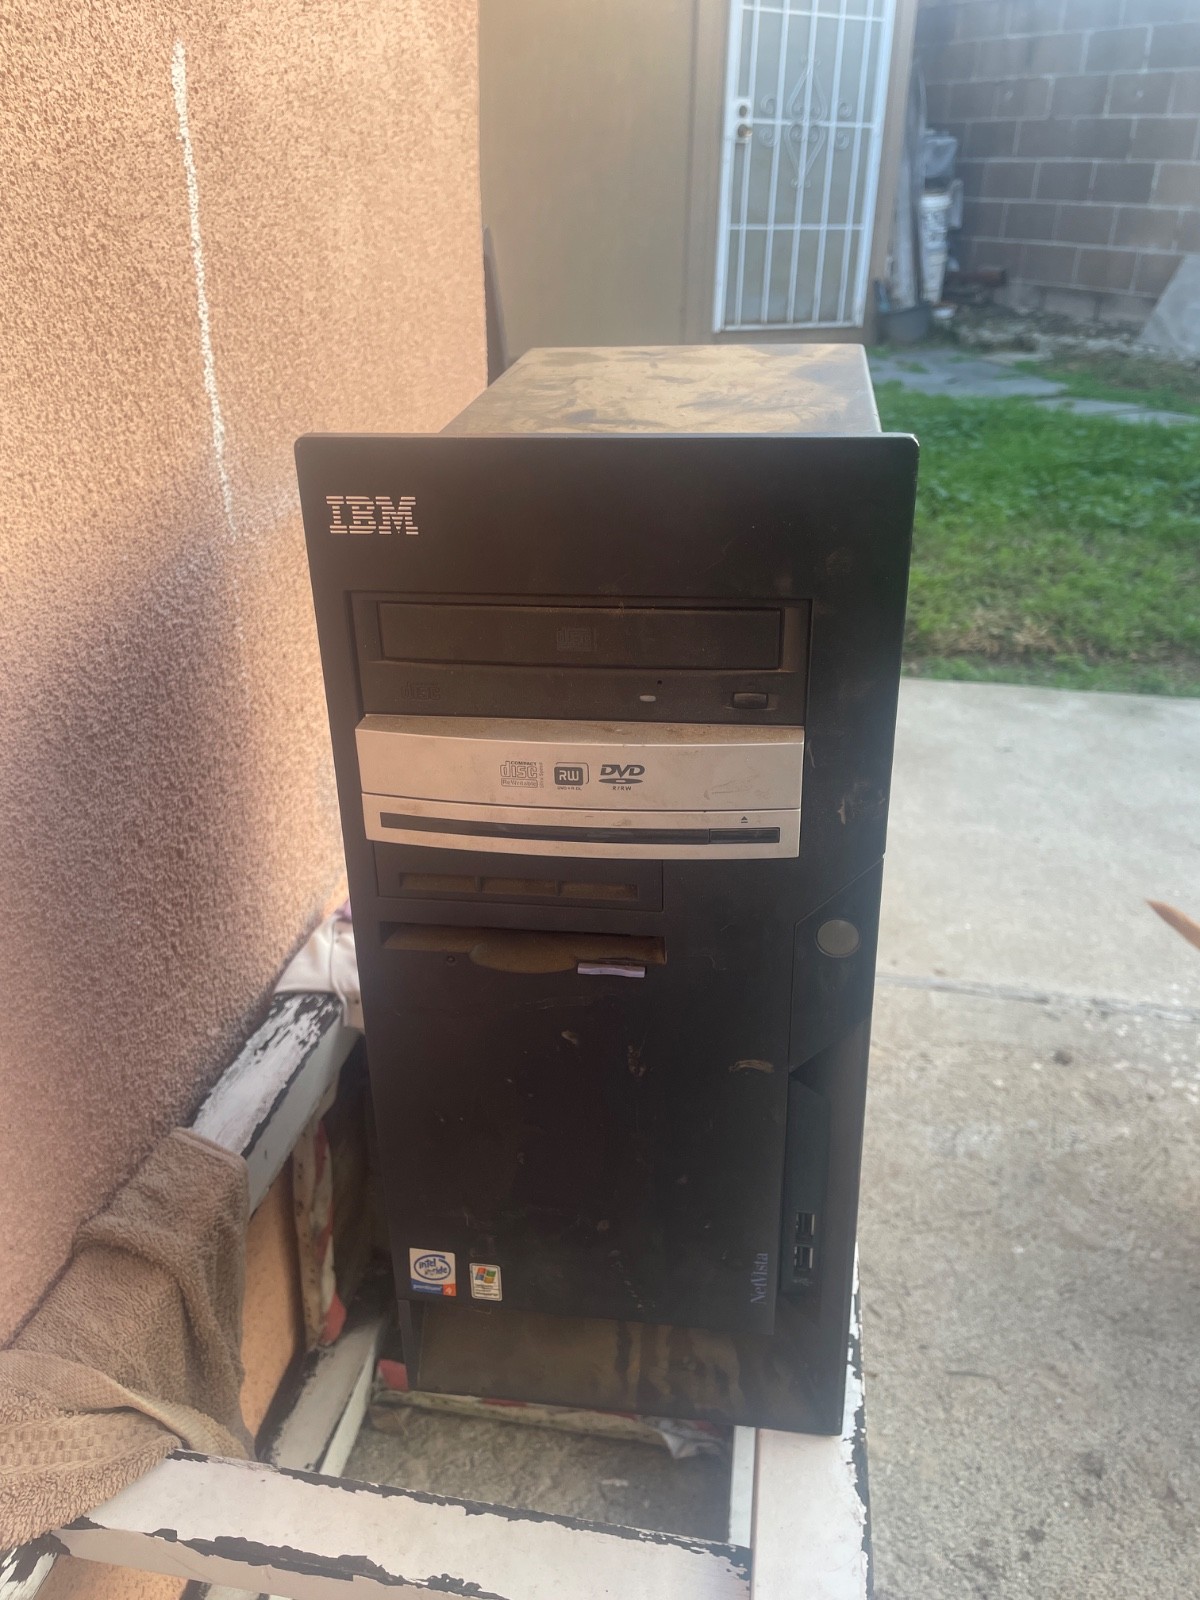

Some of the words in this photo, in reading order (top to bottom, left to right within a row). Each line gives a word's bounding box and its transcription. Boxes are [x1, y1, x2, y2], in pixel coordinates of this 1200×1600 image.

[326, 495, 419, 535] IBM
[500, 760, 538, 779] disc
[559, 769, 579, 781] RW
[600, 764, 646, 778] DVD
[750, 1252, 769, 1305] NetVista
